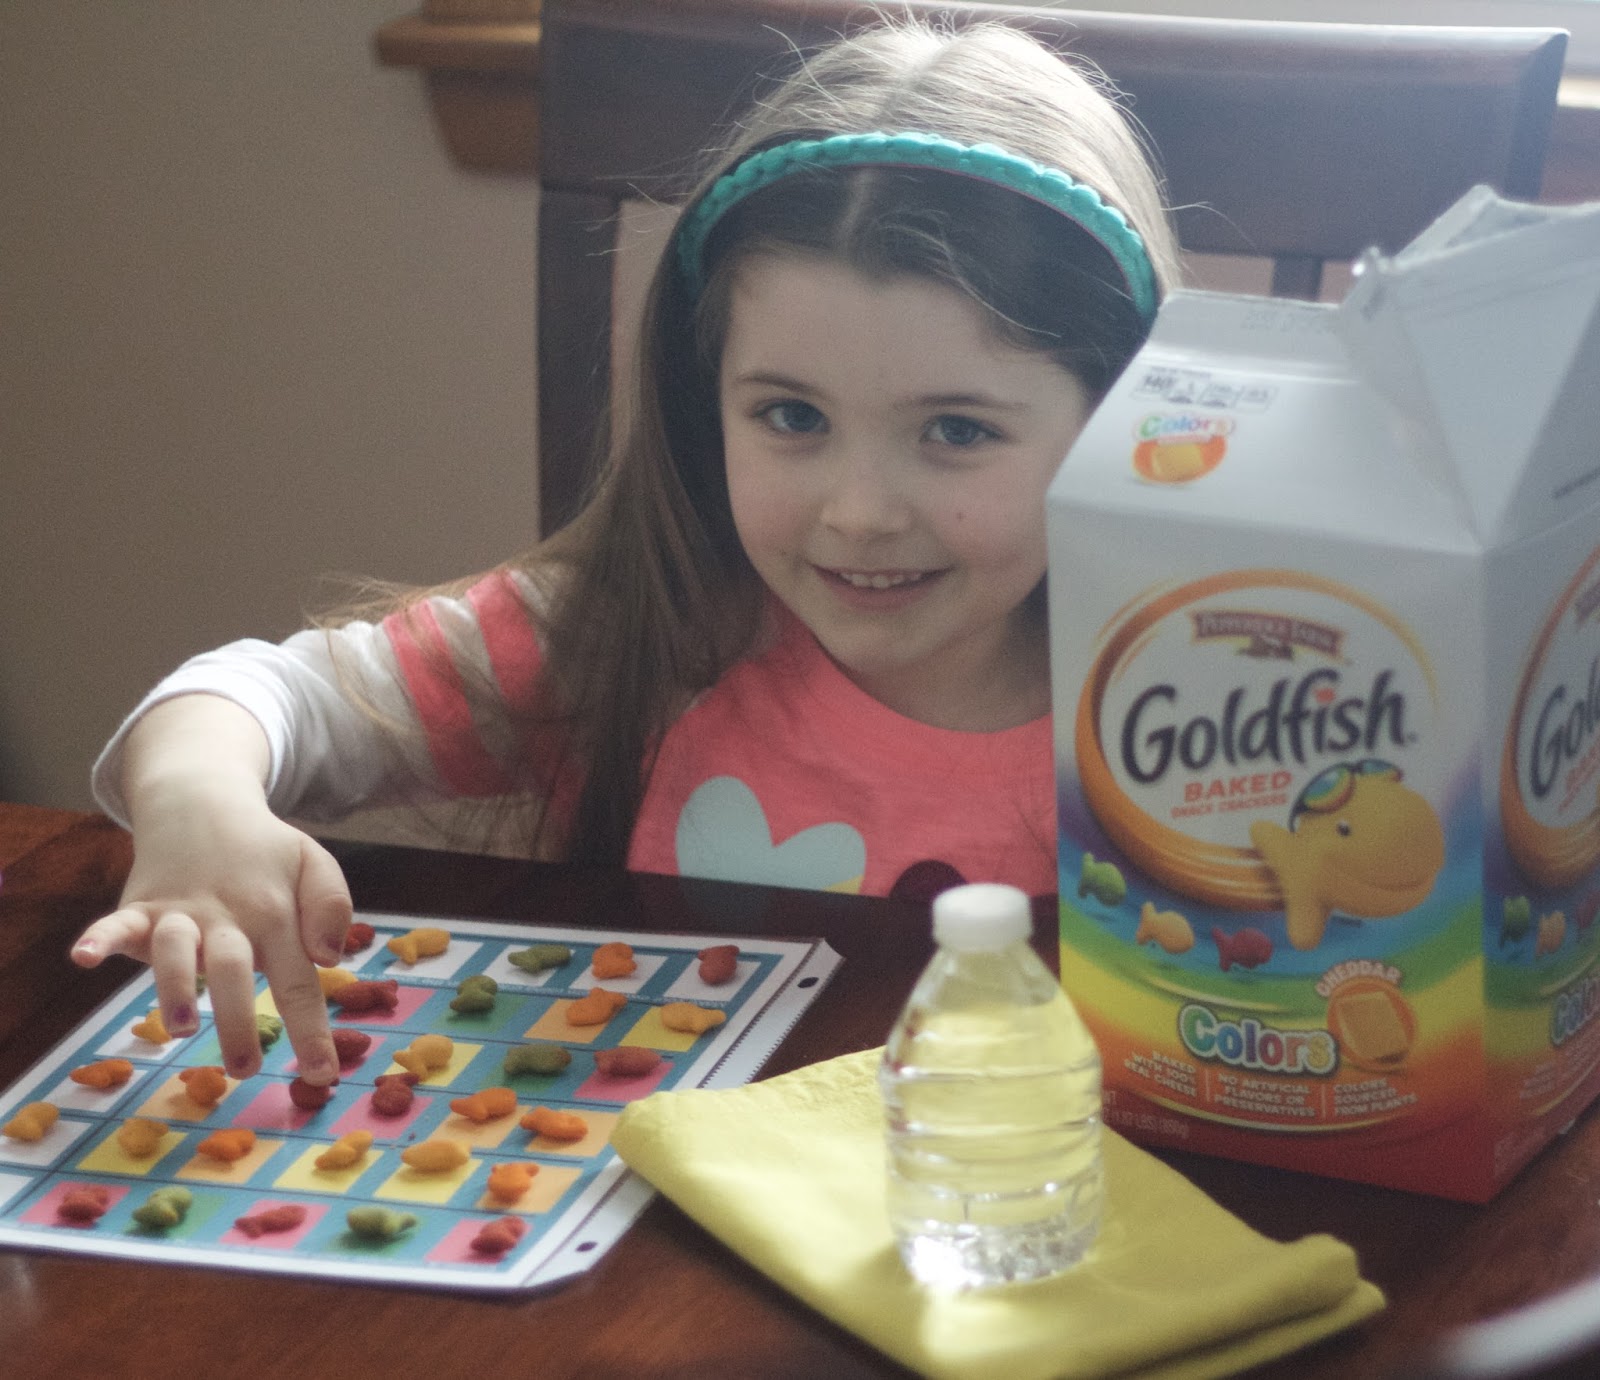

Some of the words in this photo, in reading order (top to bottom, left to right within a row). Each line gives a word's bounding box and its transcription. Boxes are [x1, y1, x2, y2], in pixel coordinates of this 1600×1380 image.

[1121, 668, 1406, 784] Goldfish
[1184, 770, 1292, 802] BAKED
[1315, 959, 1402, 997] CHEDDAR
[1179, 1003, 1337, 1075] Colors
[1218, 1073, 1238, 1086] NO
